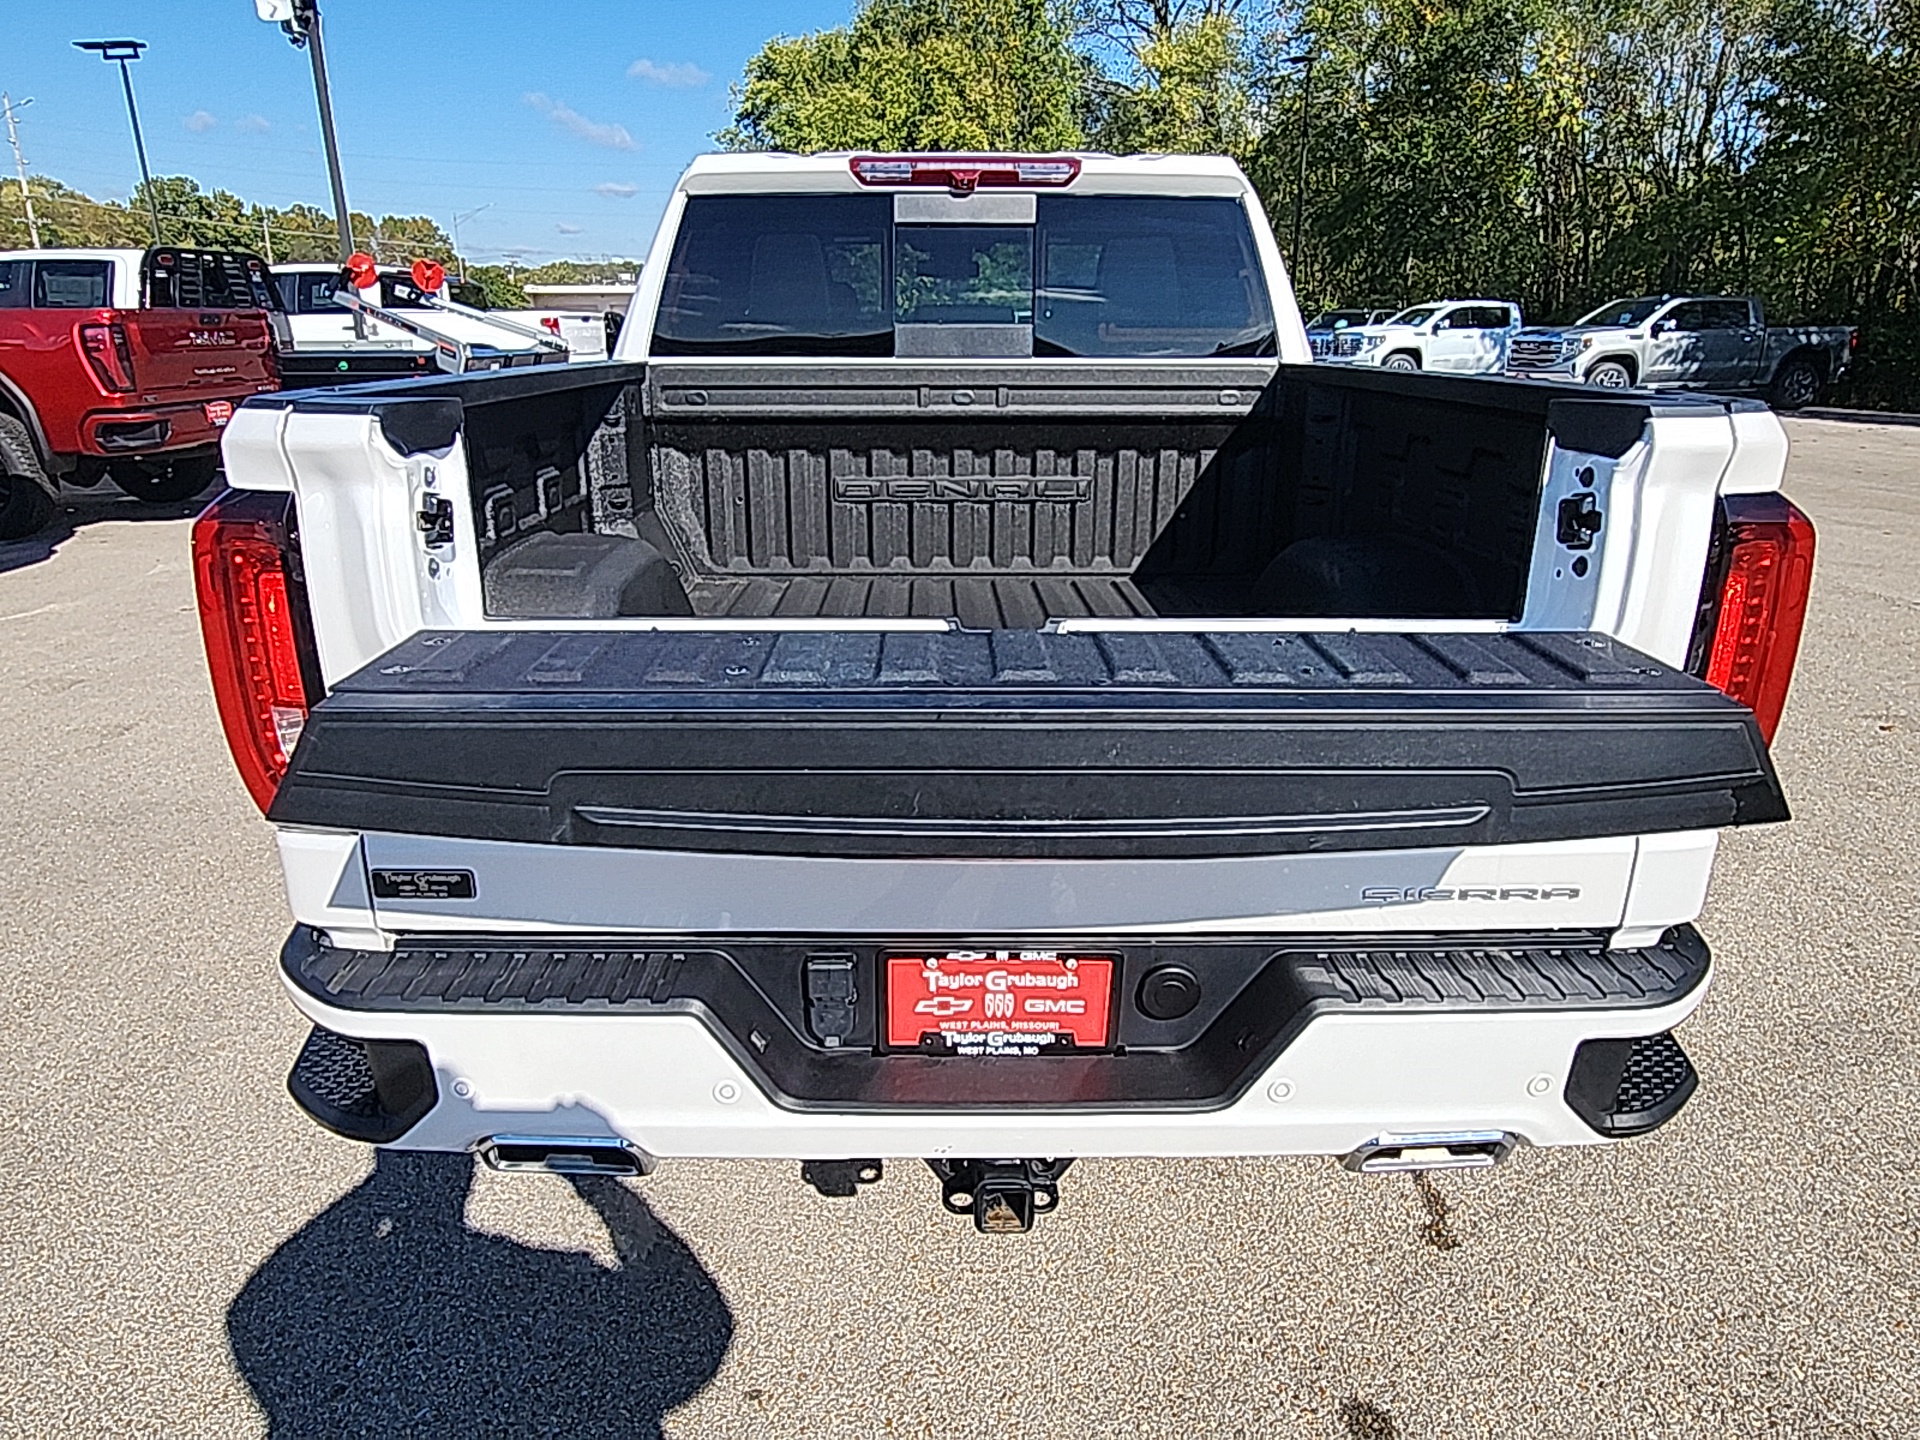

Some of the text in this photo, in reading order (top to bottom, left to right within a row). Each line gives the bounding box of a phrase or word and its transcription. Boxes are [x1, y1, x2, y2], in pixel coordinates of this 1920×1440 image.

[837, 479, 1091, 501] DENALI
[1361, 886, 1581, 902] SIERRA
[1020, 952, 1057, 961] GMC
[922, 970, 1079, 993] Taylor Grubaugh
[1024, 999, 1086, 1014] GMC
[939, 1021, 1060, 1031] WEST PLAINS, MISSOURI
[942, 1031, 1056, 1047] Taylor Grubaugh
